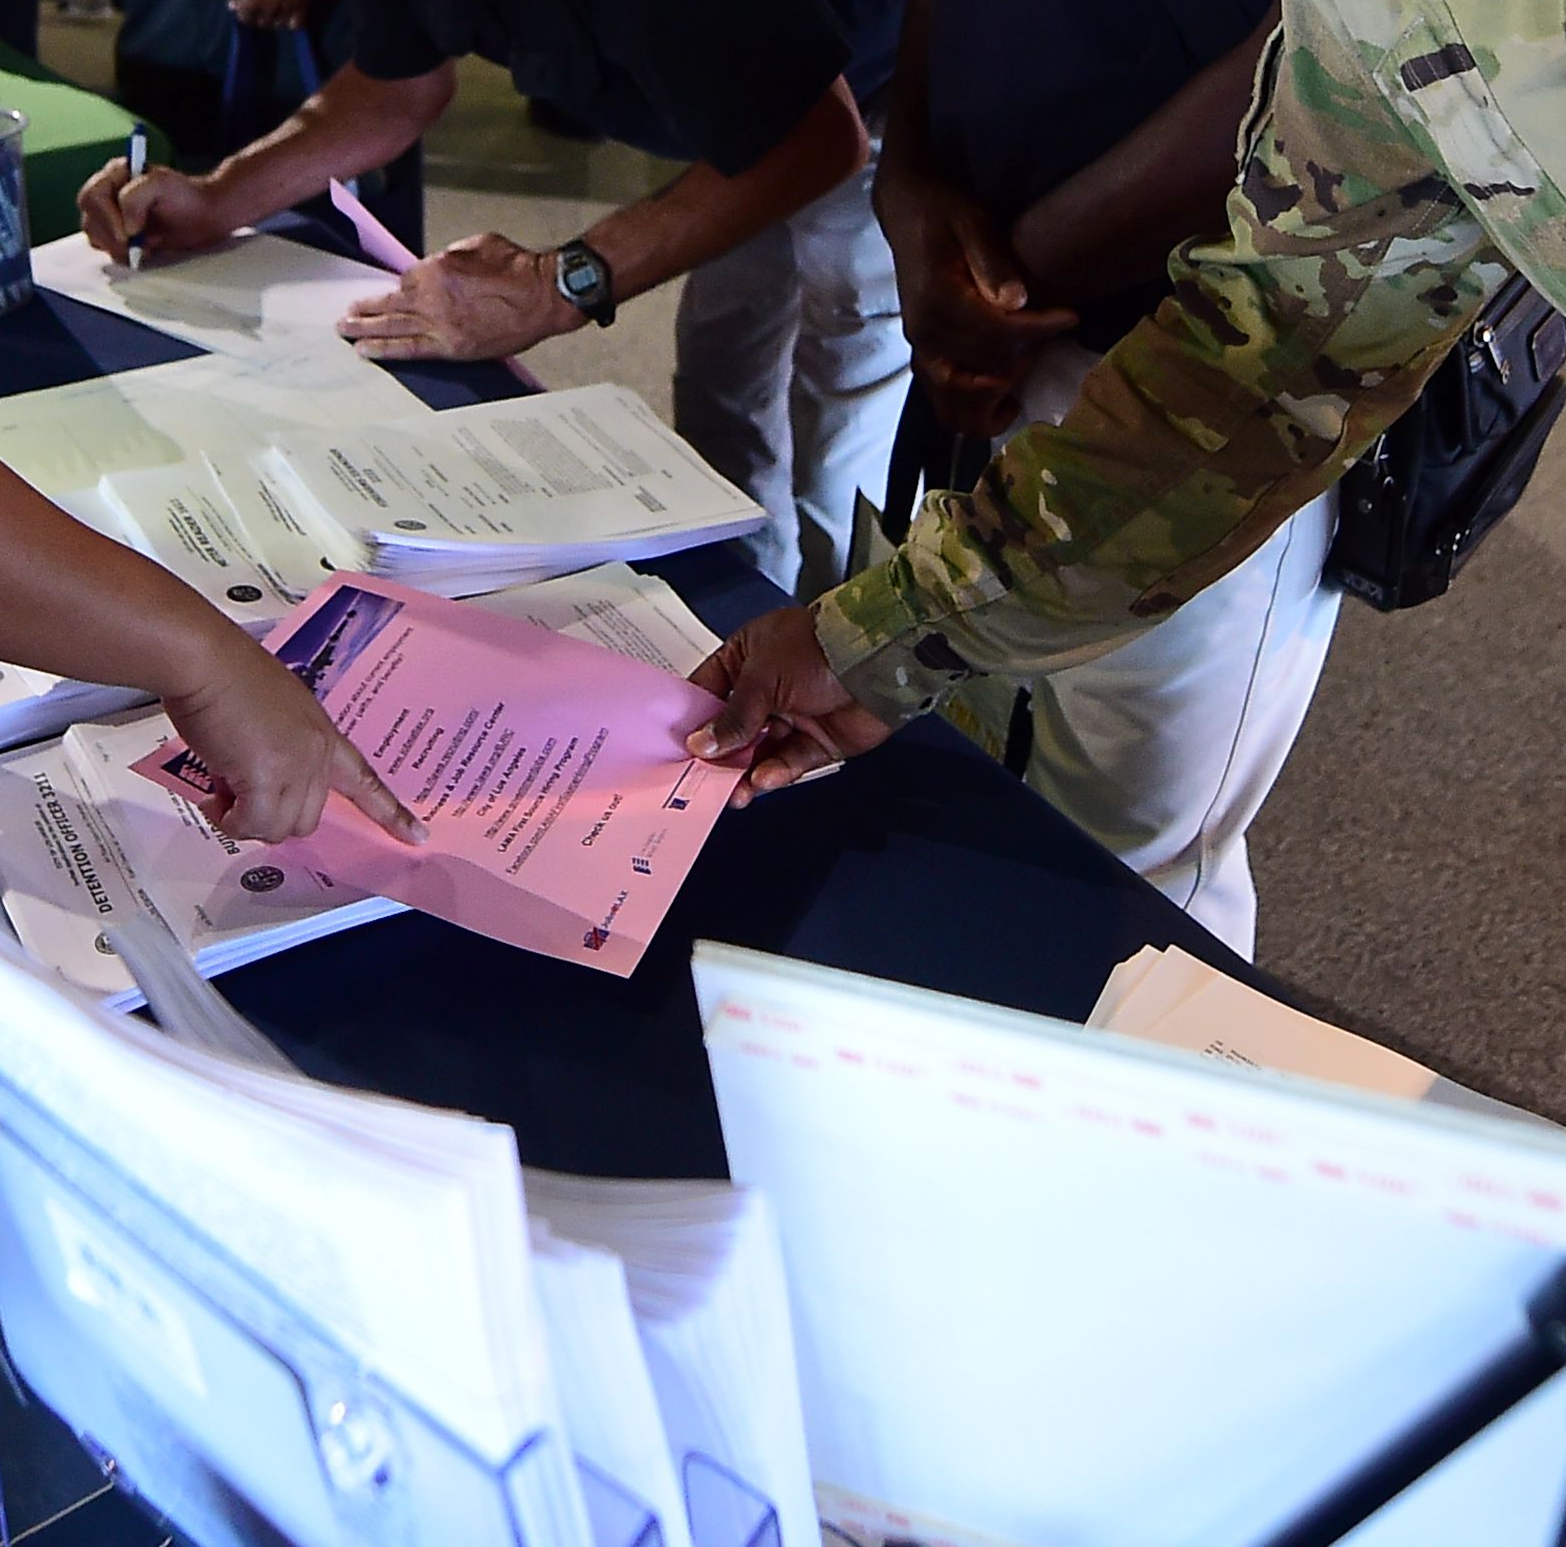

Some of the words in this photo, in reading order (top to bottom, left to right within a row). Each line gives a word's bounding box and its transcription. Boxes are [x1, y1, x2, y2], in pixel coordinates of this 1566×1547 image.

[373, 708, 409, 759] Employment
[413, 727, 444, 769] Recruiting
[33, 772, 55, 798] 3211
[422, 792, 450, 823] Business
[450, 765, 466, 784] Job
[461, 730, 489, 767] Resource
[485, 703, 505, 730] Center
[476, 800, 493, 819] City
[492, 776, 507, 794] Los
[503, 747, 527, 779] Angeles
[46, 799, 78, 842] OFFICER
[497, 832, 516, 853] LAWA
[511, 814, 528, 833] First
[540, 772, 559, 794] Hiring
[554, 737, 579, 772] Program
[582, 820, 605, 847] Check
[607, 792, 623, 812] out!
[68, 843, 113, 913] DETENTION
